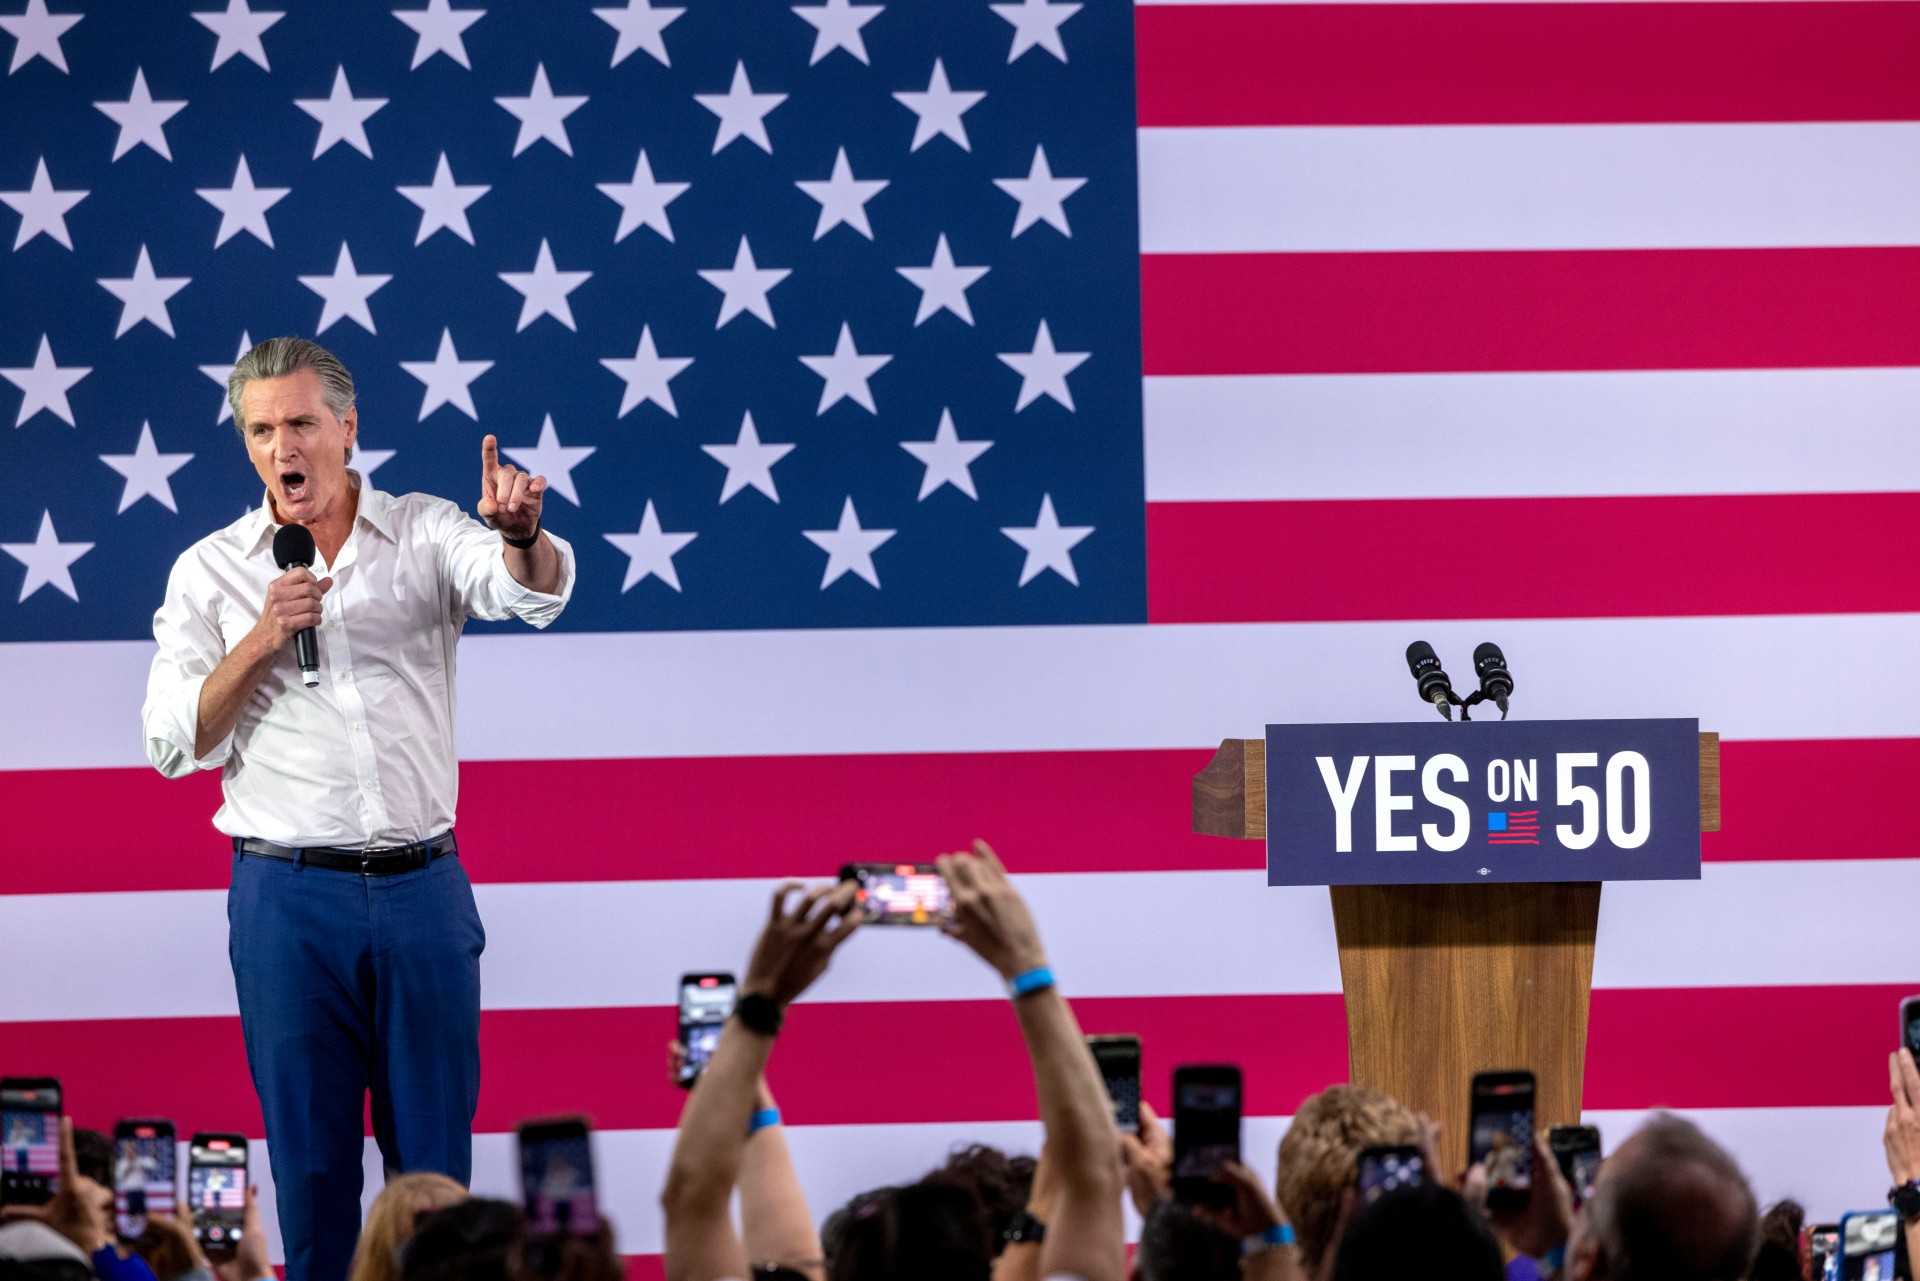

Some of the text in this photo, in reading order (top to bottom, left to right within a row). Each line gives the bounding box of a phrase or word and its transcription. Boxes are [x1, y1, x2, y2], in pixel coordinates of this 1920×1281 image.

[1315, 750, 1651, 853] YES ON 50
